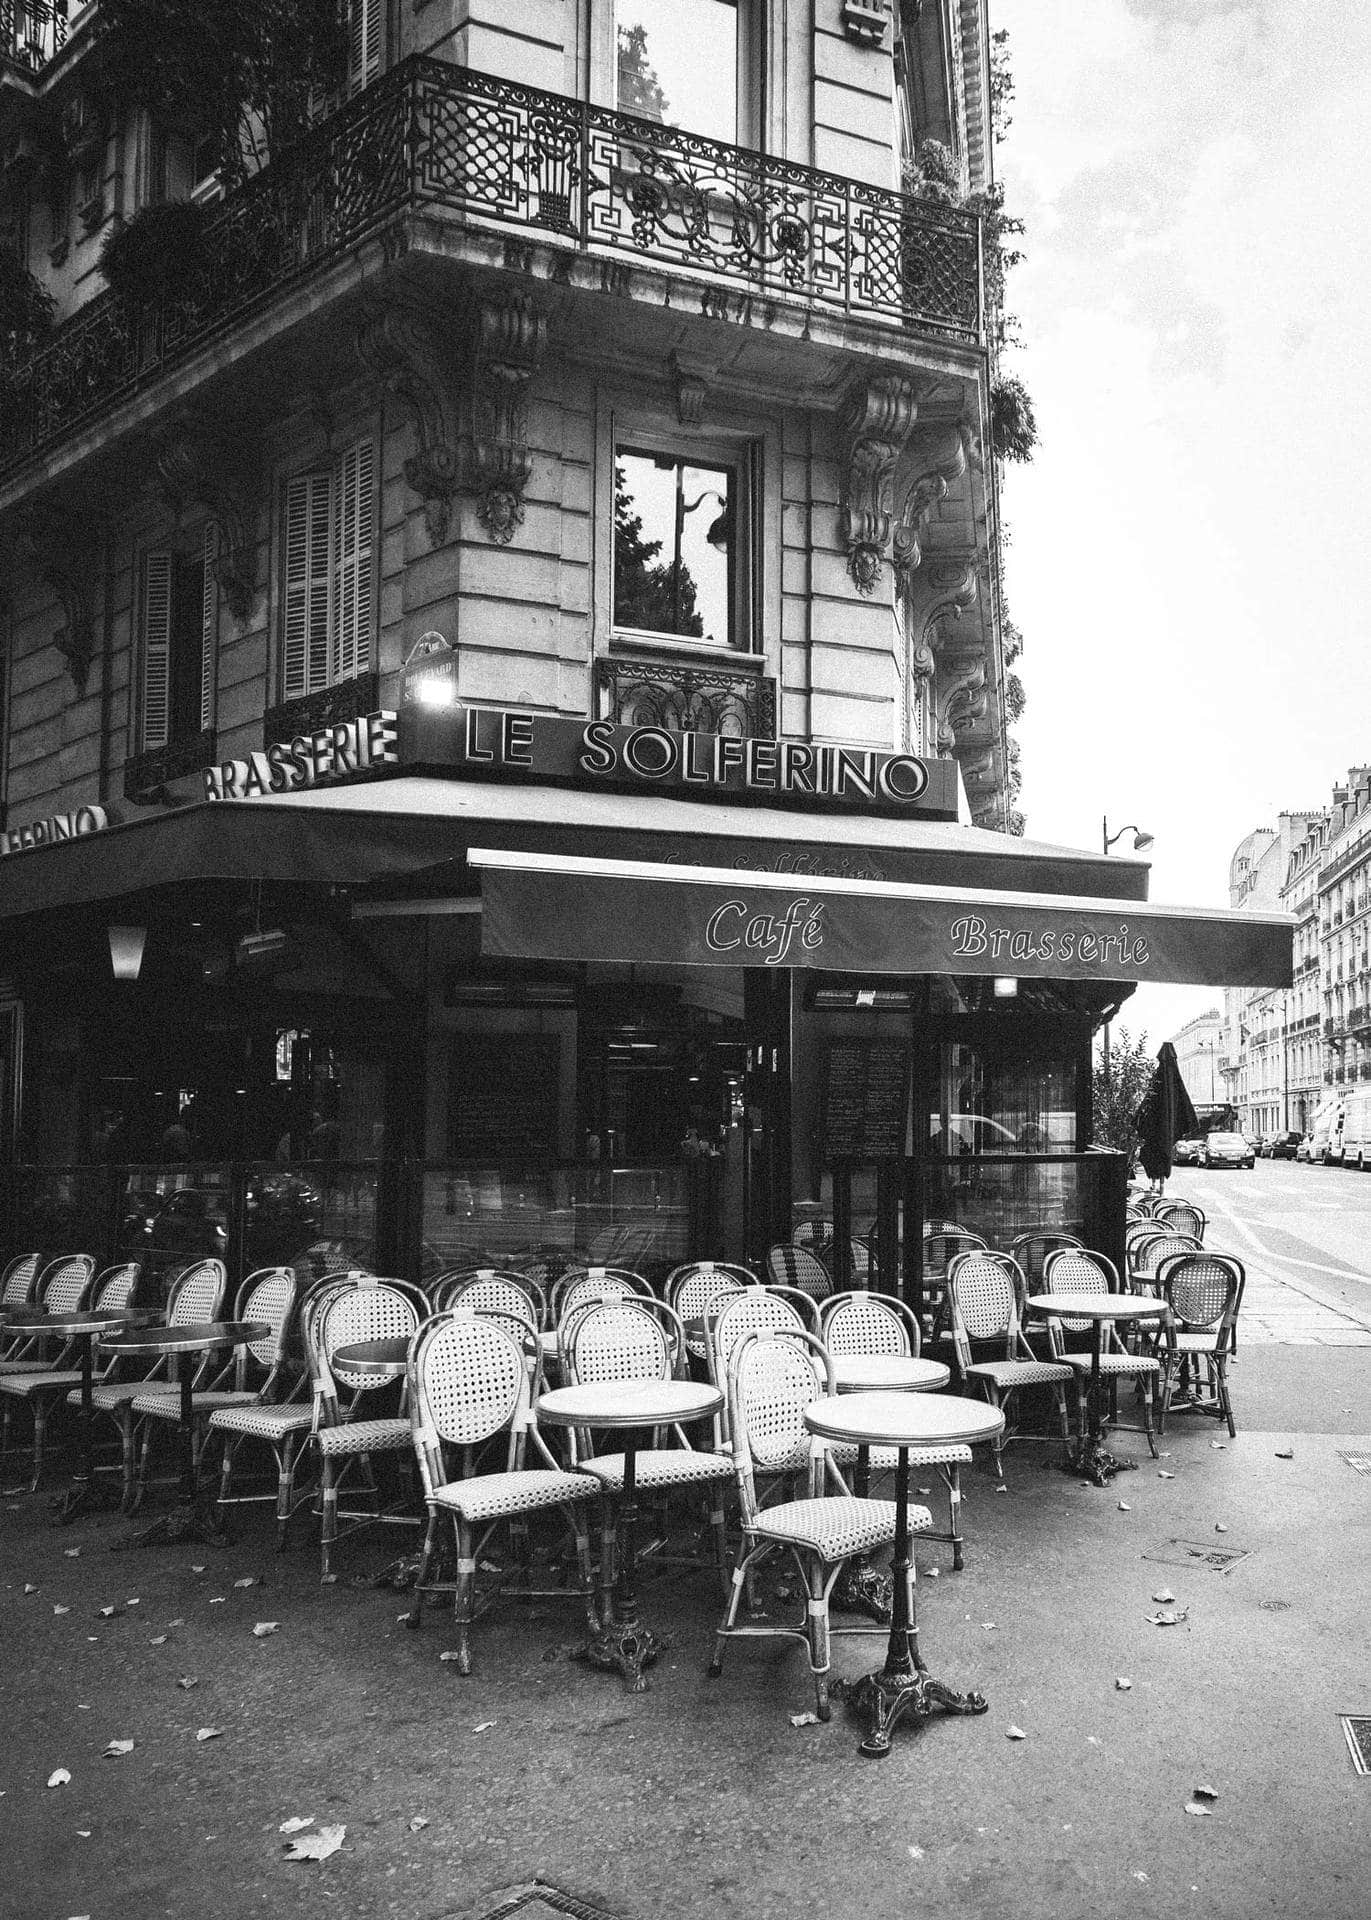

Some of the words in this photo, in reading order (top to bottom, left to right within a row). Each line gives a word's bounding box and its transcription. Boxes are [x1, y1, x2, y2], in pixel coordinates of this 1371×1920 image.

[0, 805, 108, 855] FERINO
[203, 709, 400, 801] BRASSERIE
[465, 707, 535, 766] LE
[579, 720, 930, 801] SOLFERINO
[705, 897, 824, 964] Café
[950, 914, 1151, 965] Brasserie
